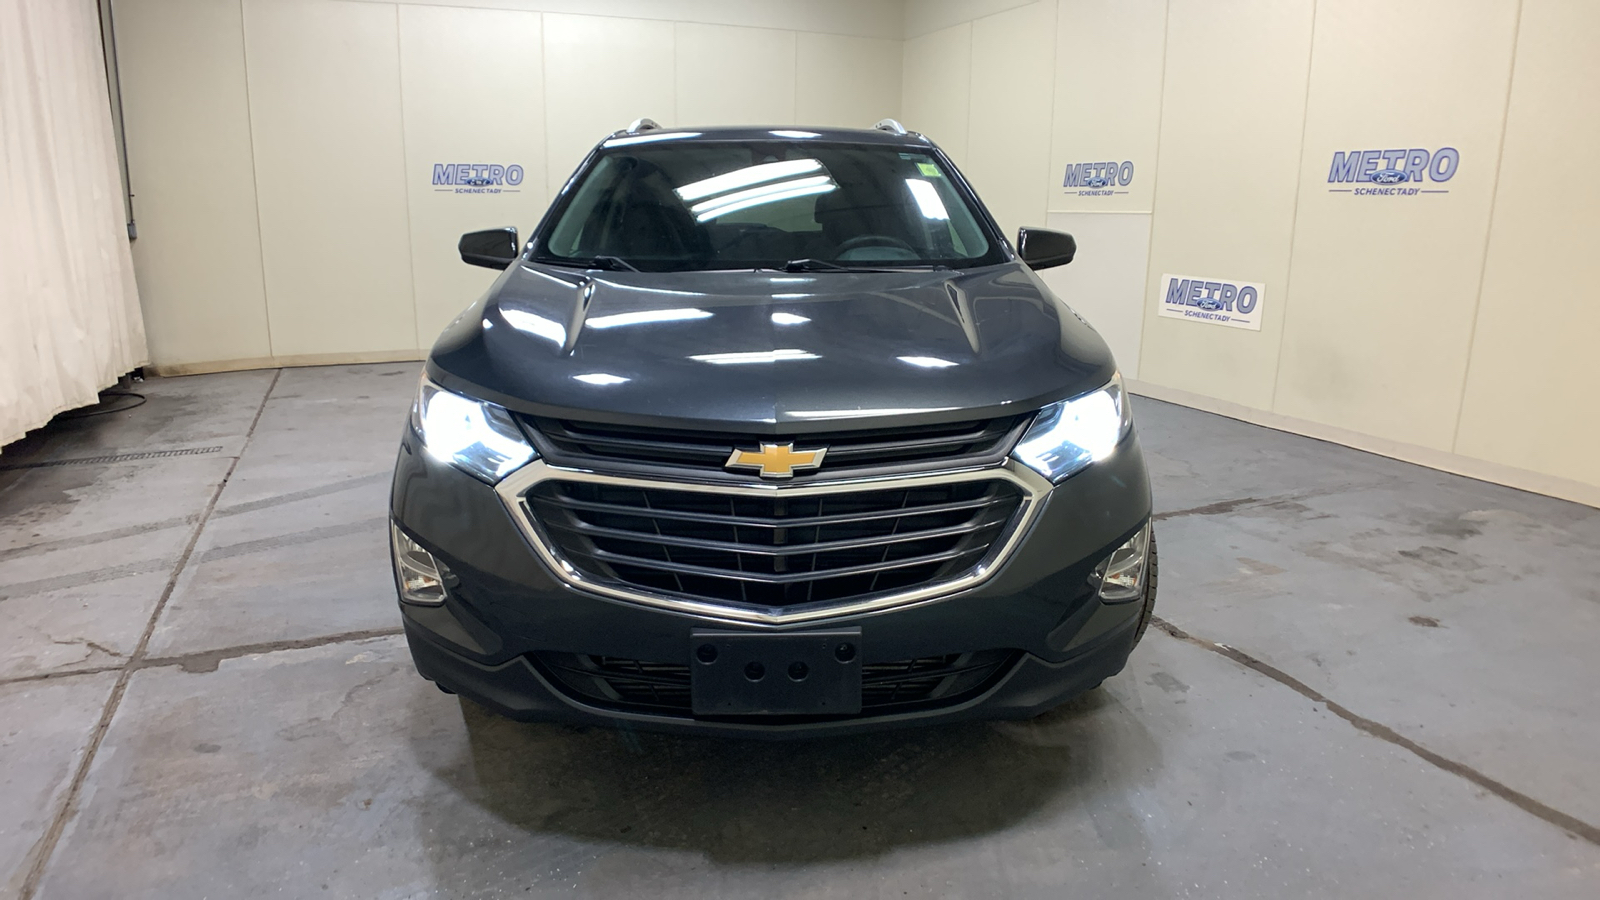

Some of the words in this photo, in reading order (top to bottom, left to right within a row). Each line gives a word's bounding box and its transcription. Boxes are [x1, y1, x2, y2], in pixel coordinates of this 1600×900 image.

[432, 163, 524, 186] METRO
[1063, 160, 1134, 188] METRO
[1327, 147, 1460, 183] METRO
[1376, 172, 1401, 183] Ford
[1354, 187, 1420, 196] SCHENECTADY
[1165, 277, 1258, 315] METRO
[1184, 309, 1231, 322] SCHENECTADY
